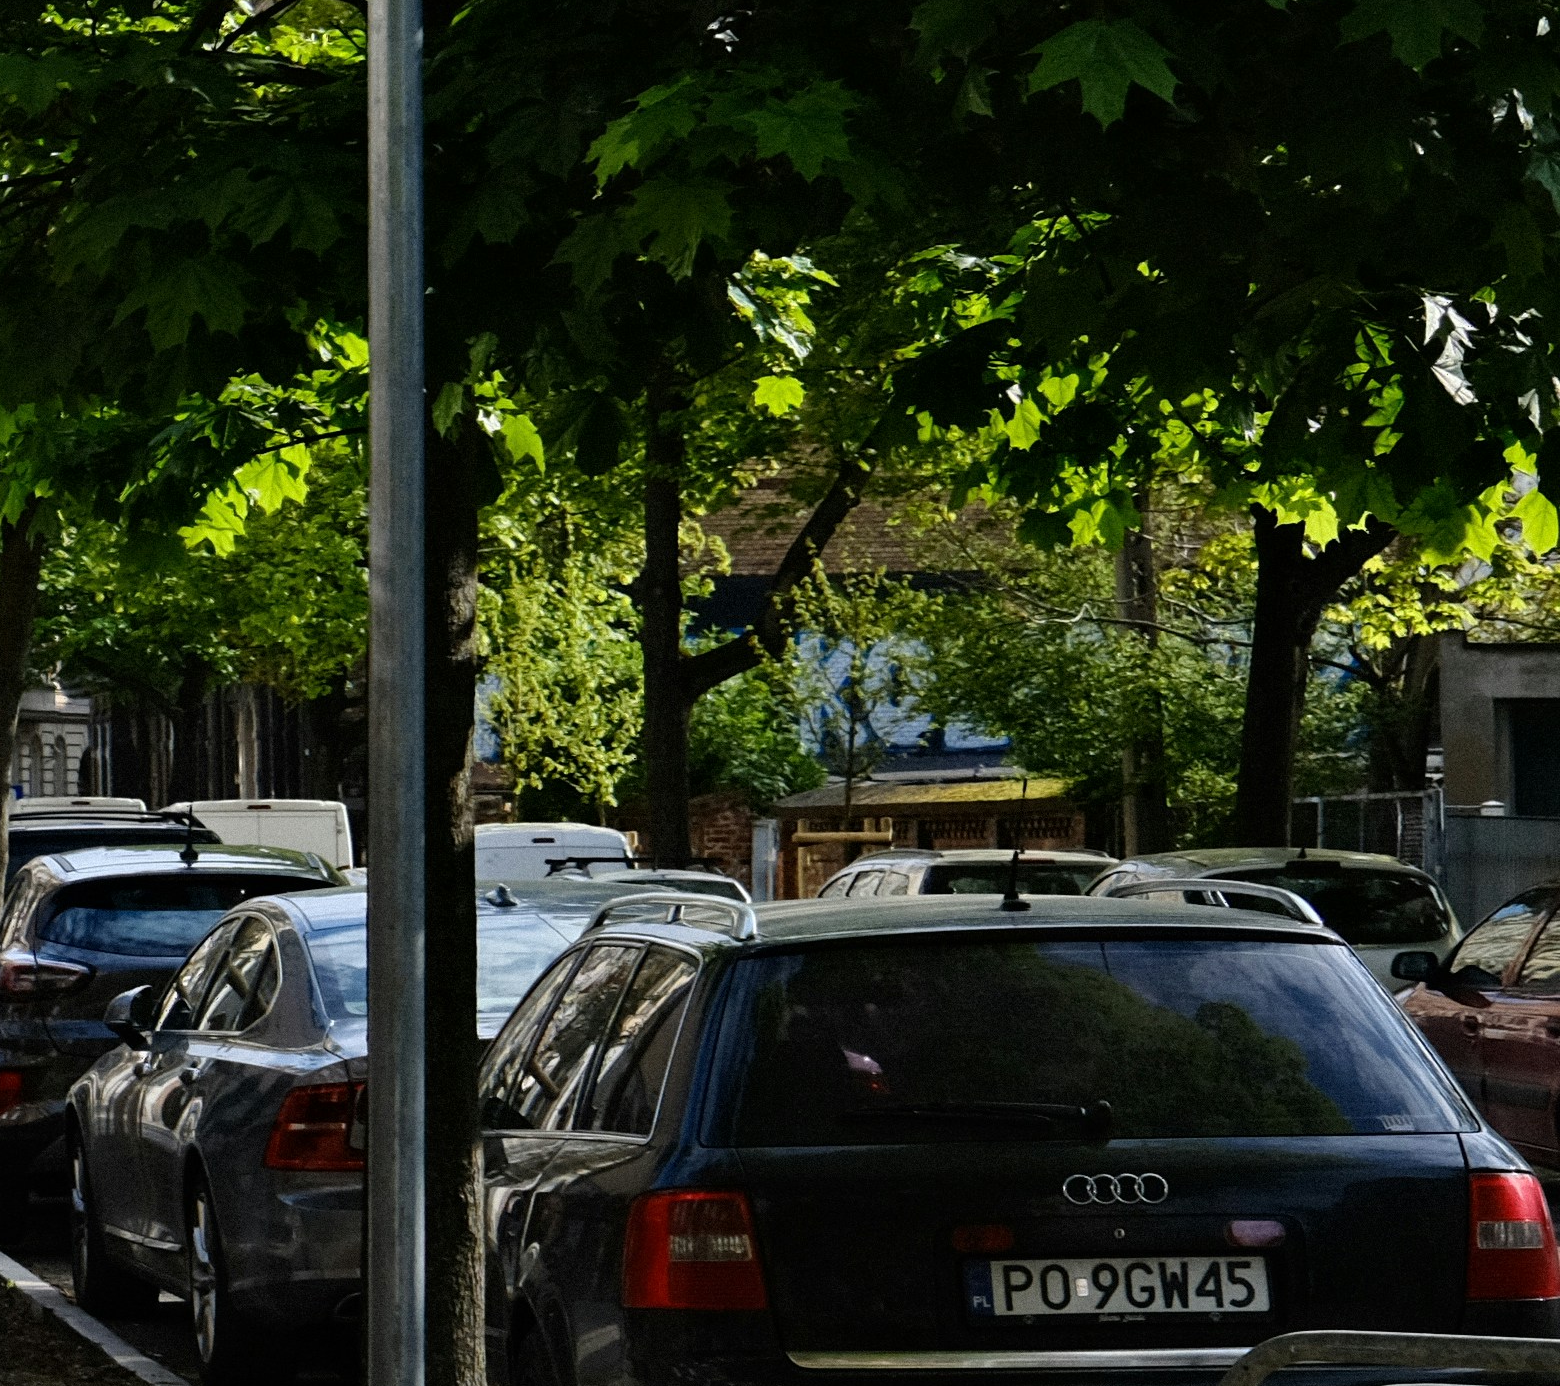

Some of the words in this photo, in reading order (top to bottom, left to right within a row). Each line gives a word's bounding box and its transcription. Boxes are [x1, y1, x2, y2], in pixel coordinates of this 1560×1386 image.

[1002, 1263, 1071, 1311] PO
[1091, 1260, 1256, 1310] 9GW45
[972, 1295, 991, 1309] PL
